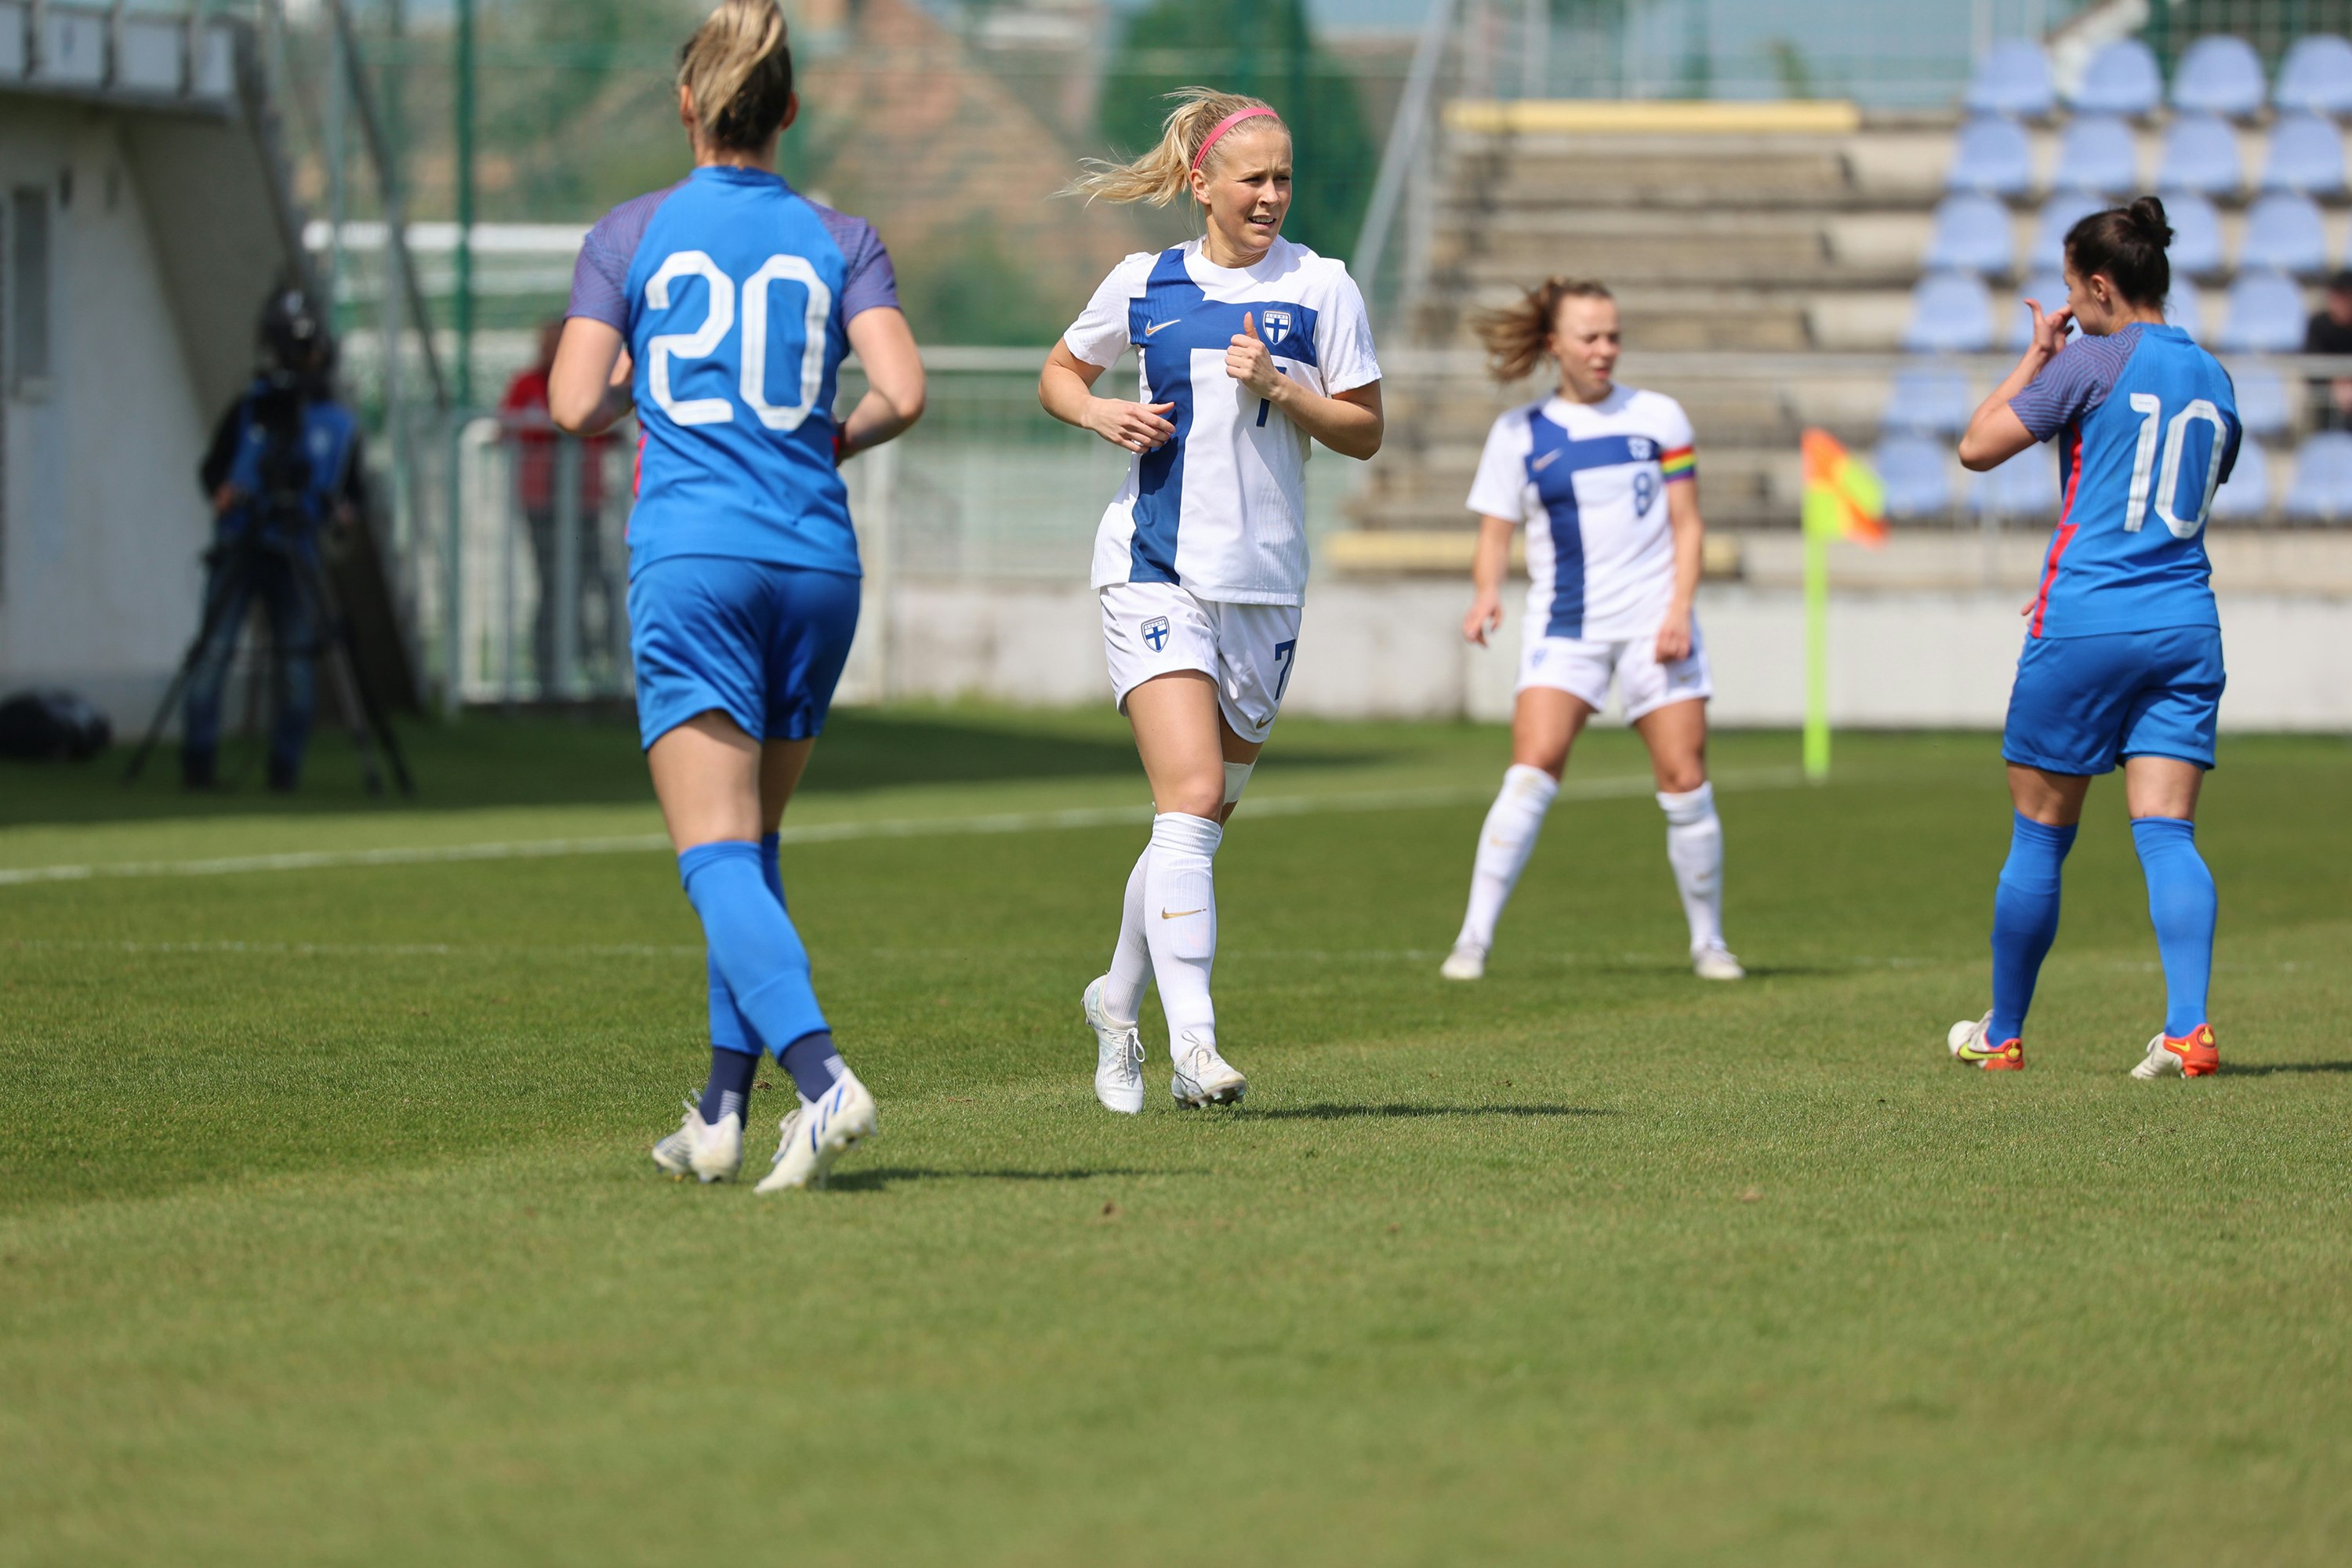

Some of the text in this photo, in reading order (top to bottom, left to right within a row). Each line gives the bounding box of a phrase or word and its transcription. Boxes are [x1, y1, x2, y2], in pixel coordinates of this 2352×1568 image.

[645, 250, 831, 430] 20
[1633, 471, 1652, 517] 8
[2124, 393, 2227, 539] 10
[1275, 639, 1296, 700] 7
